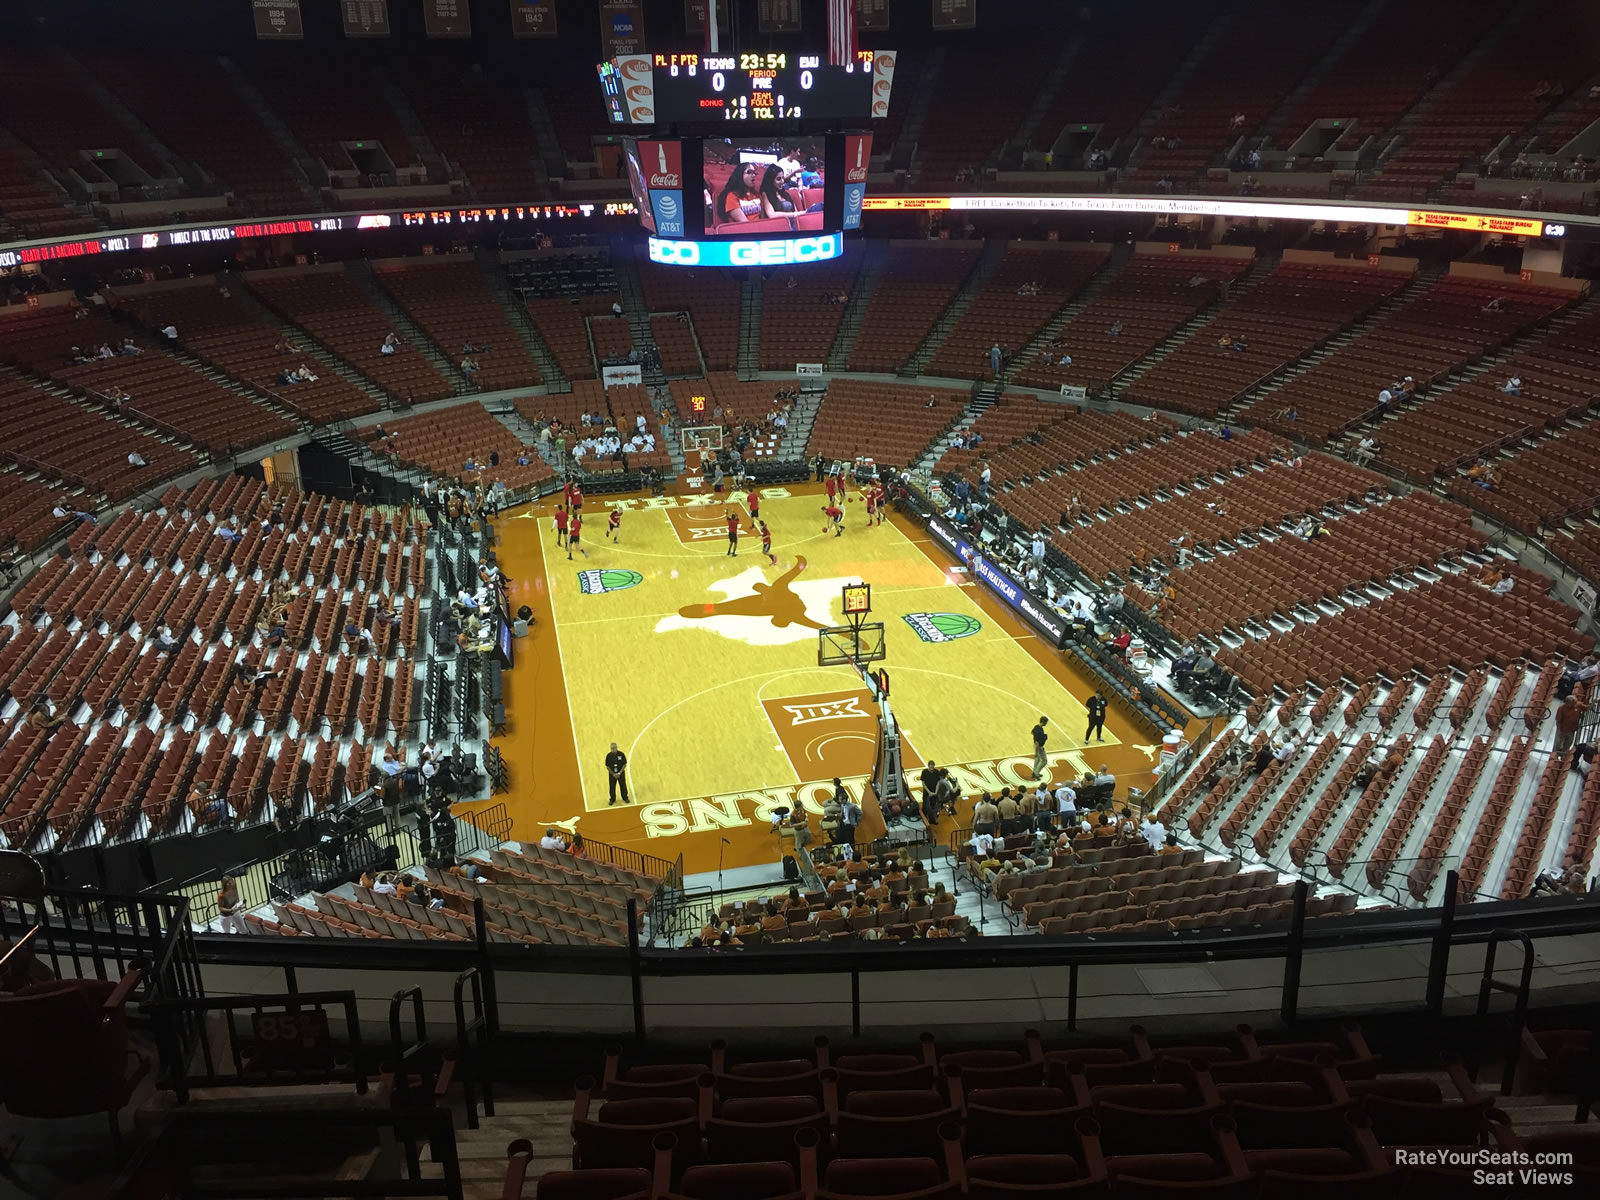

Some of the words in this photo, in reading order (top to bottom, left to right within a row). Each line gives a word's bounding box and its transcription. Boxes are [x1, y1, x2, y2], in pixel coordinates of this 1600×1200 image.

[655, 55, 667, 66] PL
[671, 55, 678, 65] F
[680, 55, 698, 65] PTS
[703, 58, 735, 69] TEXAS
[740, 54, 786, 69] 23:54
[712, 72, 725, 91] 0
[800, 70, 813, 90] 0
[753, 92, 772, 100] TEAM
[700, 99, 724, 107] BONUS
[750, 98, 775, 106] FOULS
[753, 107, 775, 118] TOL
[321, 218, 338, 231] APRIL
[845, 214, 860, 225] AT&T
[660, 221, 681, 232] AT&T
[107, 238, 124, 251] APRIL
[729, 234, 836, 266] GEICO
[1369, 256, 1379, 265] 22
[1521, 271, 1532, 281] 21
[27, 297, 39, 307] 32
[693, 402, 705, 411] 30
[604, 487, 792, 512] TEXAS
[986, 567, 1017, 600] HEALTHCARE
[639, 750, 1100, 840] LONORNS
[256, 1015, 299, 1041] 85
